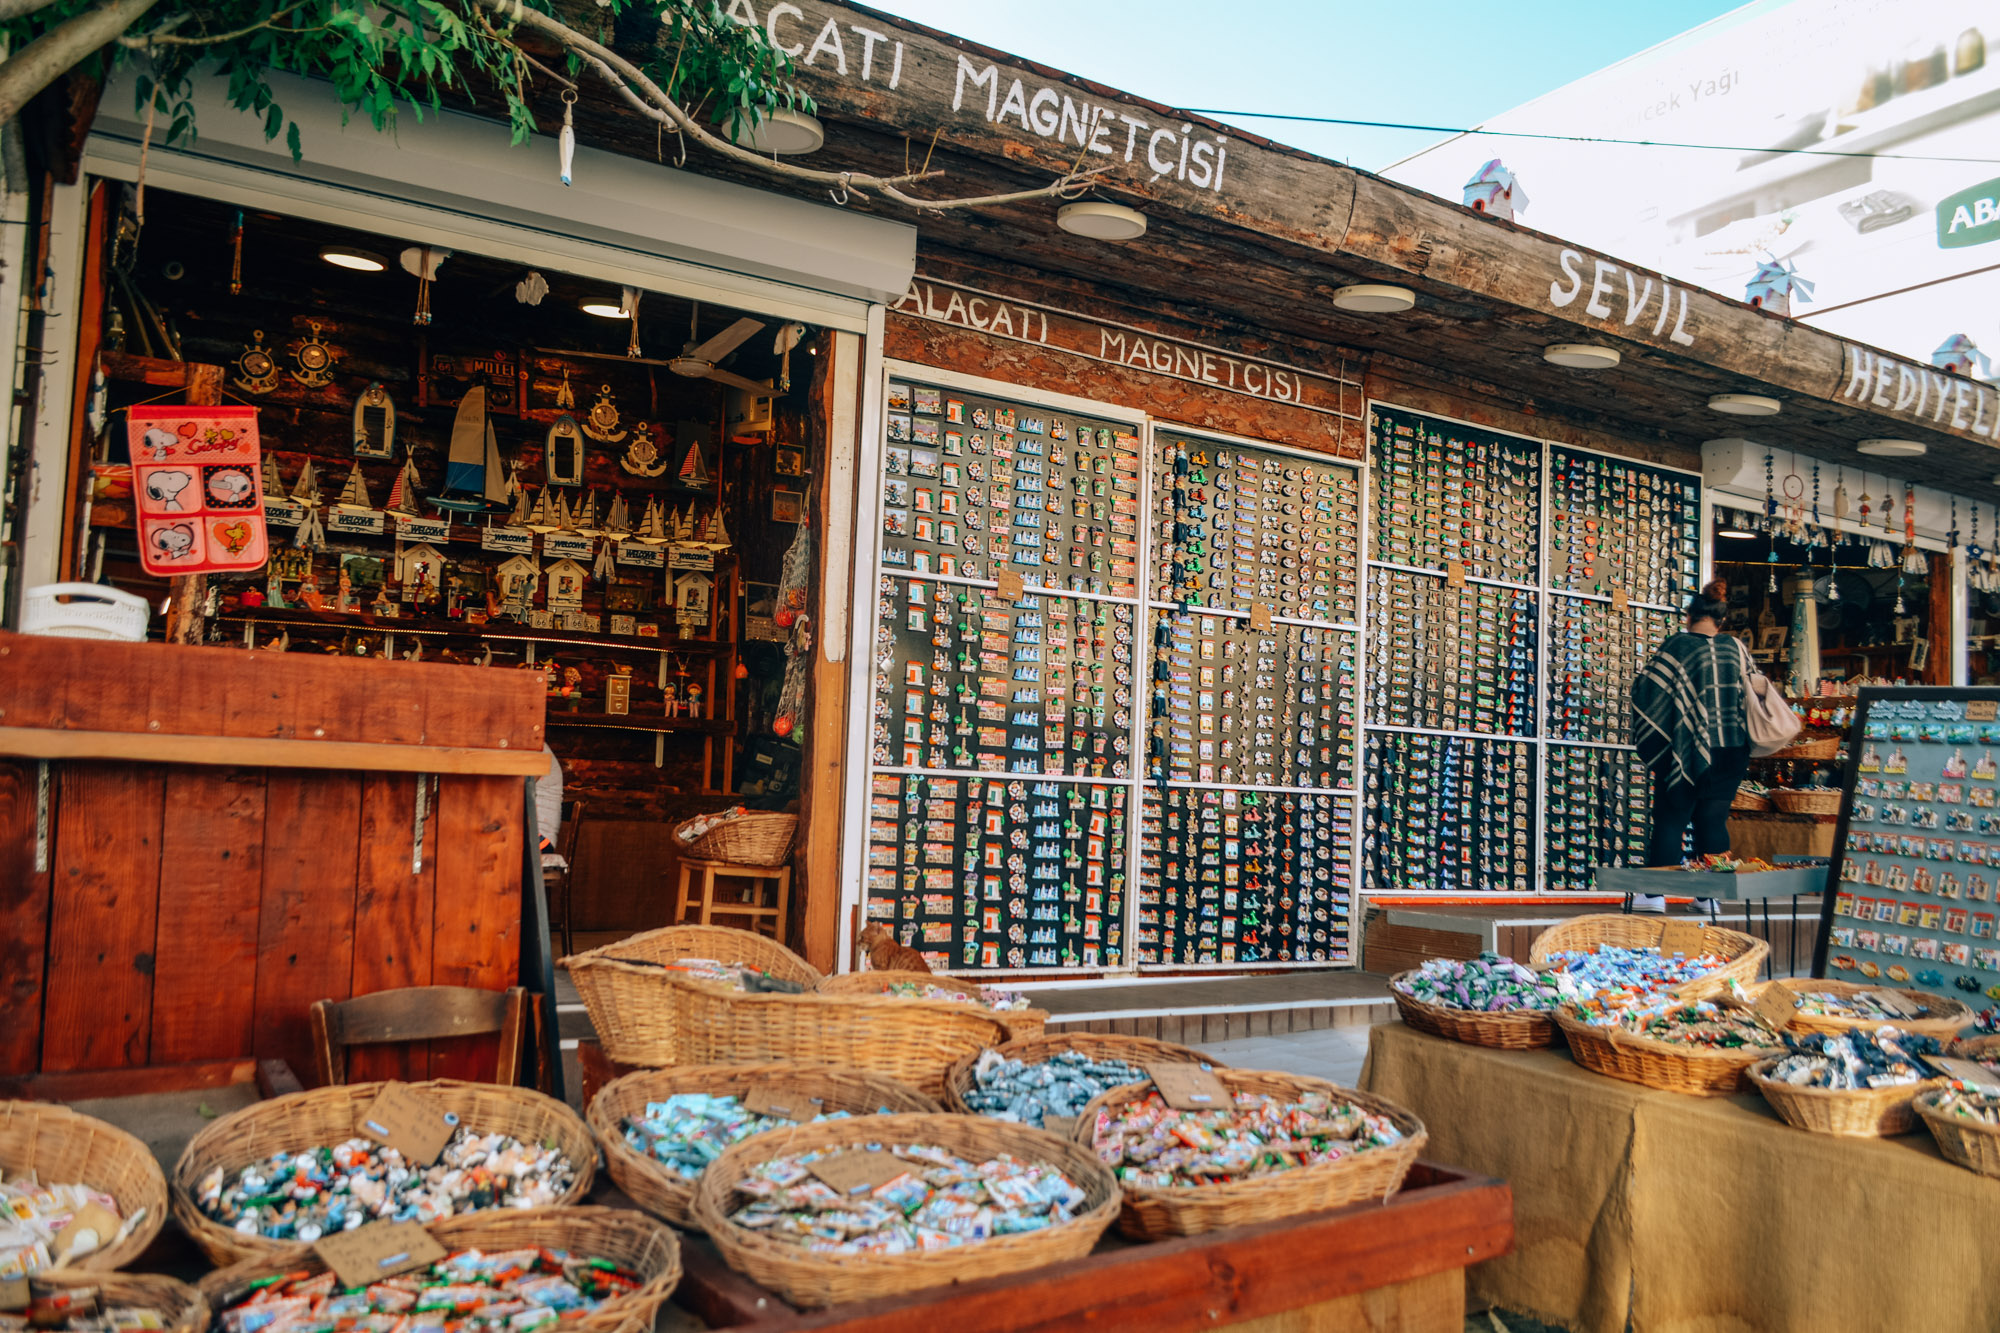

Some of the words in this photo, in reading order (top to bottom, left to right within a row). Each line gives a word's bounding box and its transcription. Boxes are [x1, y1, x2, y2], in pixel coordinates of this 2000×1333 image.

[474, 361, 515, 376] MOTEL
[184, 437, 240, 455] Snoopy
[338, 515, 375, 526] WELCOME
[410, 525, 447, 536] WELCOME
[494, 533, 529, 543] WELCOME
[554, 539, 587, 550] WELCOME
